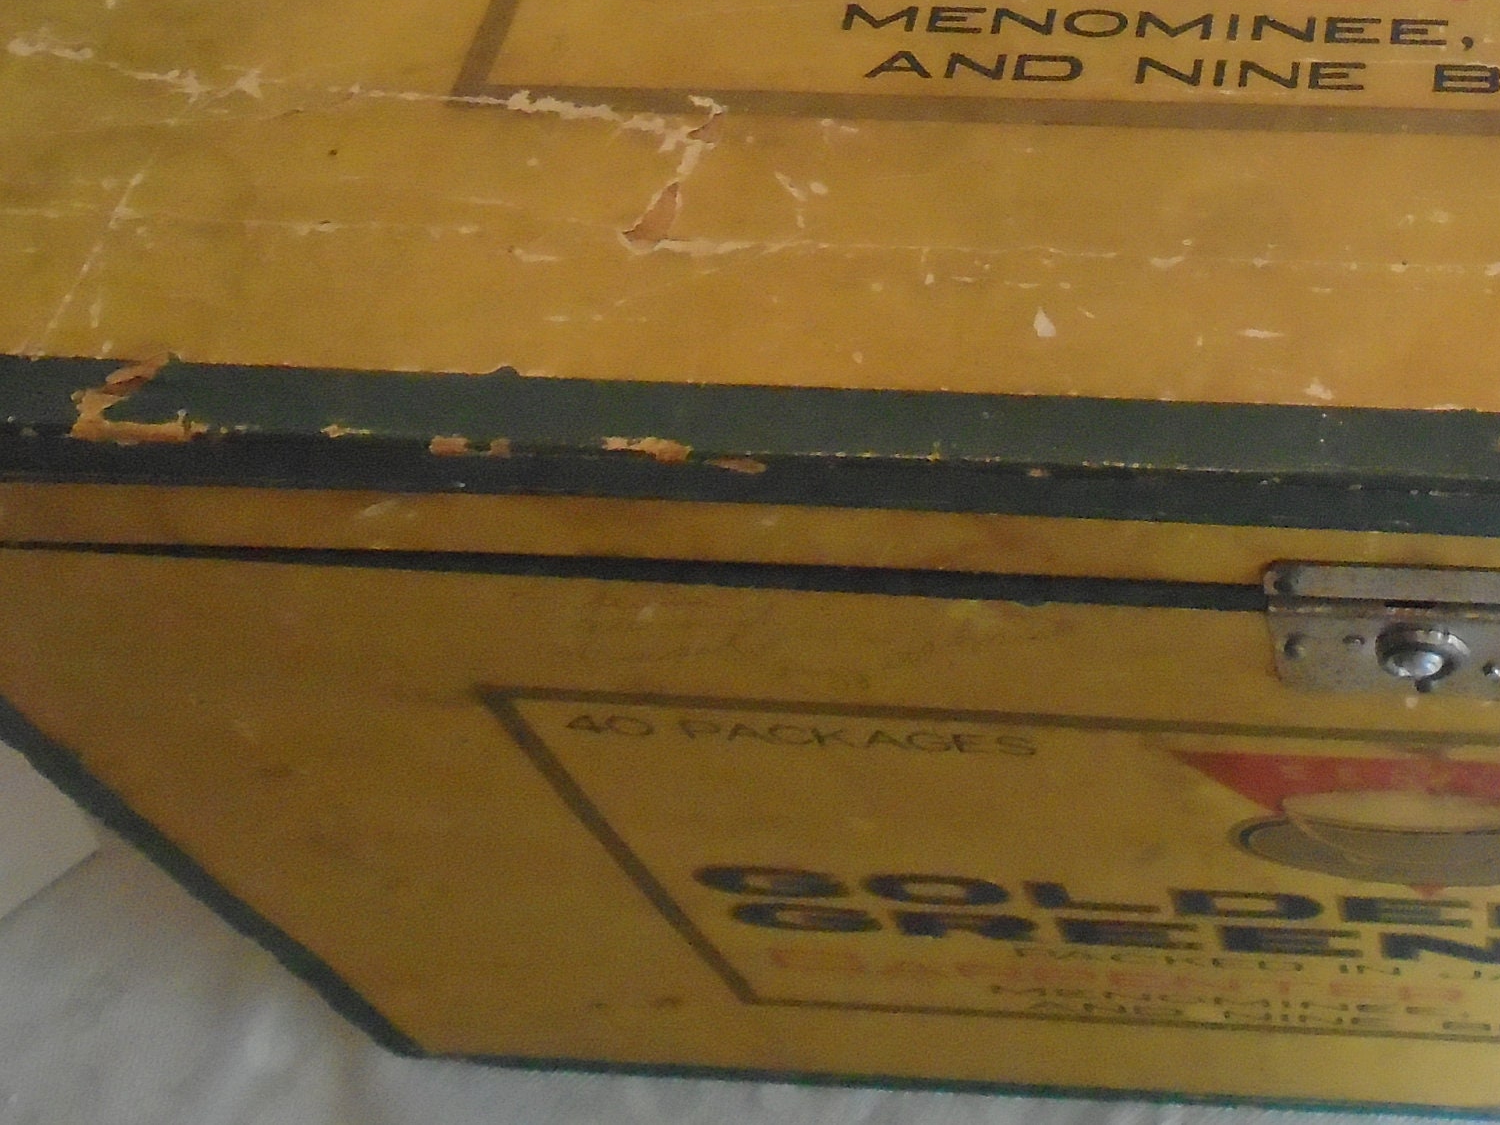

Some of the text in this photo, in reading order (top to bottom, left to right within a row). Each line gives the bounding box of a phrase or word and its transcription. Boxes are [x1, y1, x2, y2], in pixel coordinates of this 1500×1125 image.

[840, 3, 1475, 51] MENOMINEE,
[864, 50, 1083, 84] AND
[1133, 54, 1365, 93] NINE
[566, 715, 1038, 757] 40 PACKAGES
